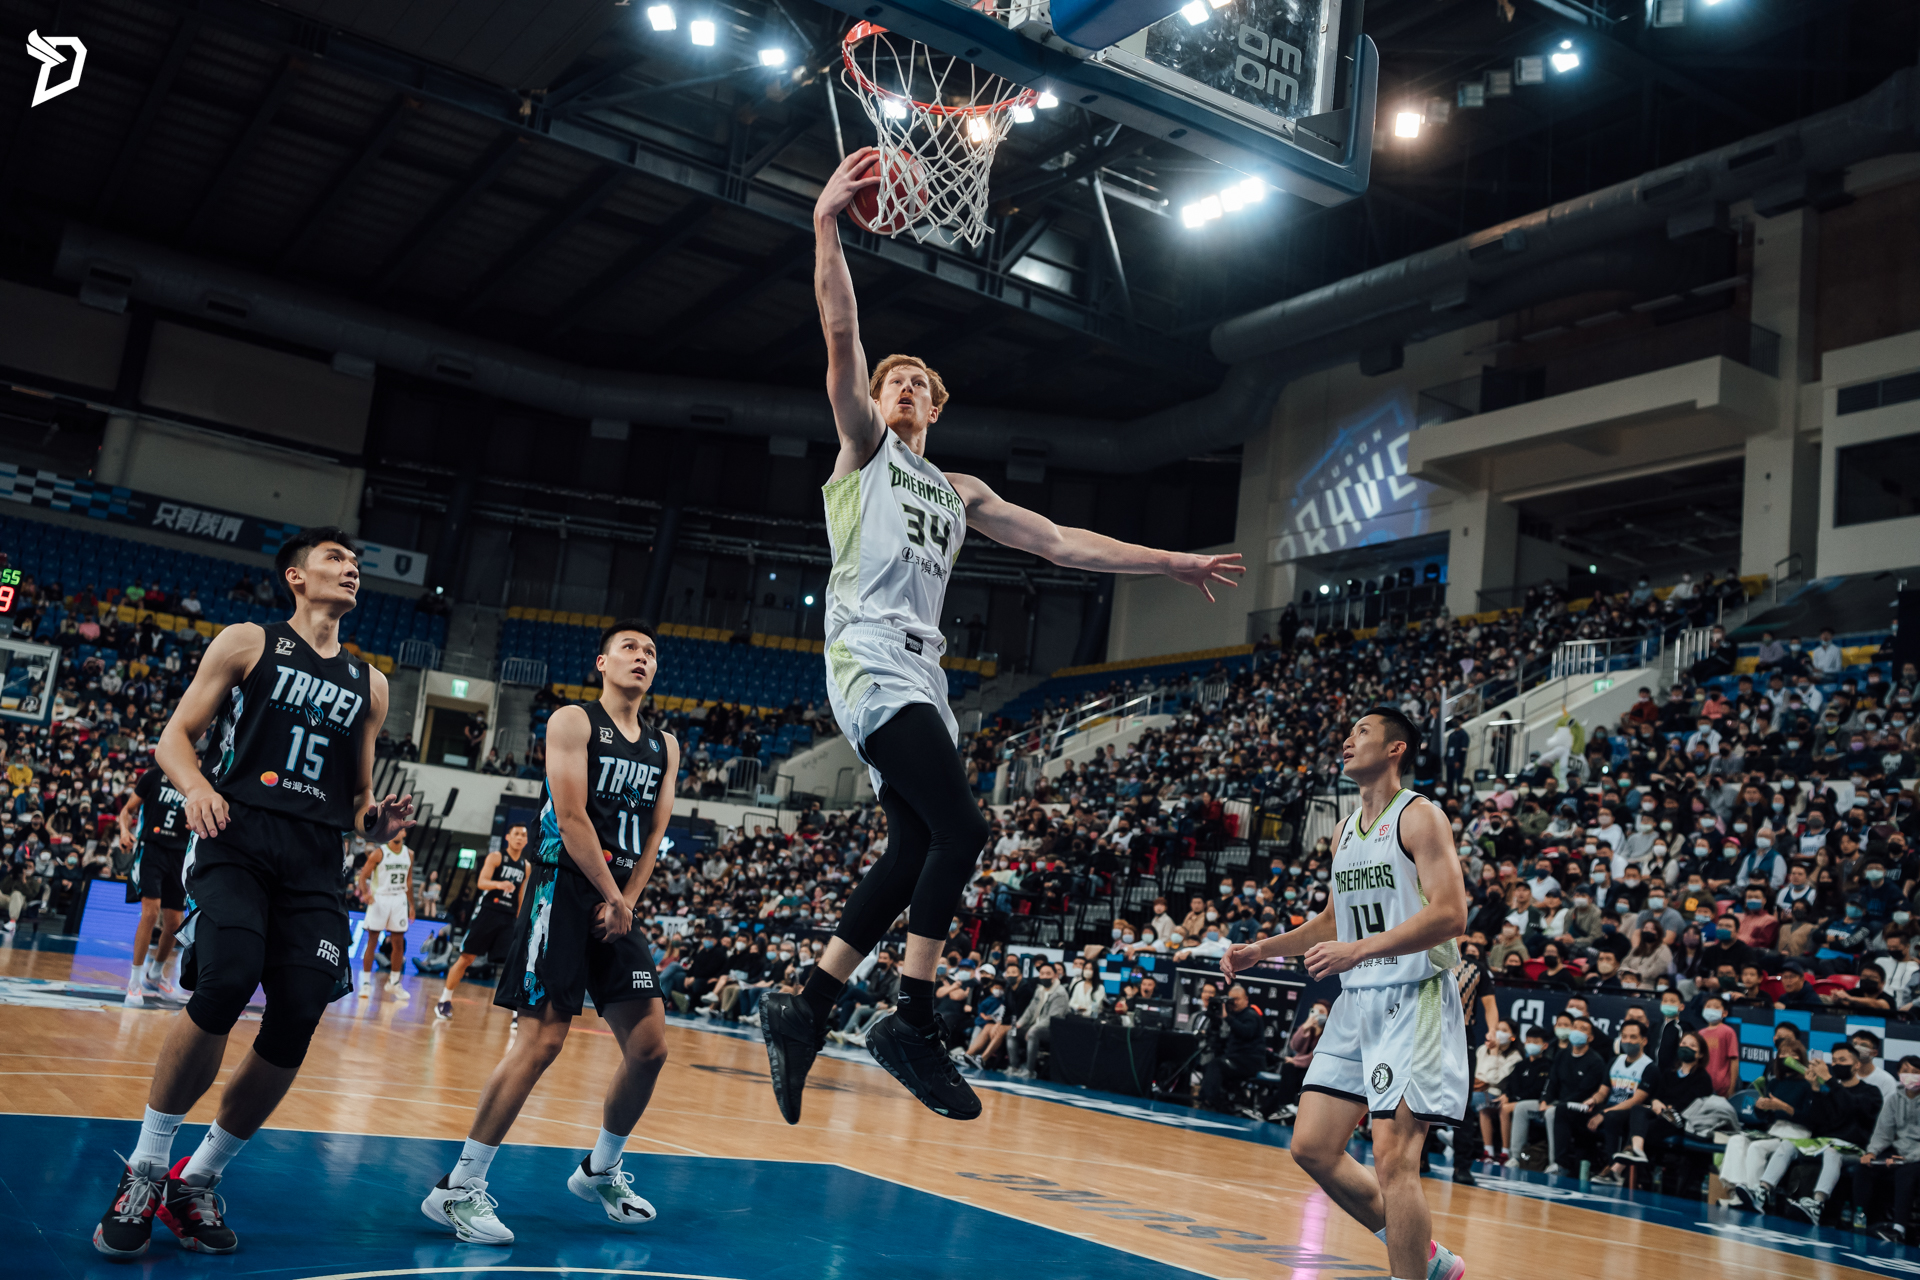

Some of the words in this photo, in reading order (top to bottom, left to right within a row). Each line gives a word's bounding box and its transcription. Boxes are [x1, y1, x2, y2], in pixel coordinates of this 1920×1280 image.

[888, 461, 960, 517] DREAMERS
[152, 501, 244, 542] 只有我們
[901, 503, 951, 557] 34
[270, 665, 363, 728] TAIPEI
[285, 725, 330, 781] 15
[282, 778, 327, 801] 台灣大哥大
[596, 756, 662, 801] TAIPE
[163, 810, 177, 829] 5
[617, 810, 642, 855] 11
[390, 873, 406, 884] 23
[615, 856, 637, 869] 台灣
[1335, 863, 1396, 895] DREAMERS
[1349, 902, 1386, 940] 14
[1741, 1046, 1770, 1062] FUBON
